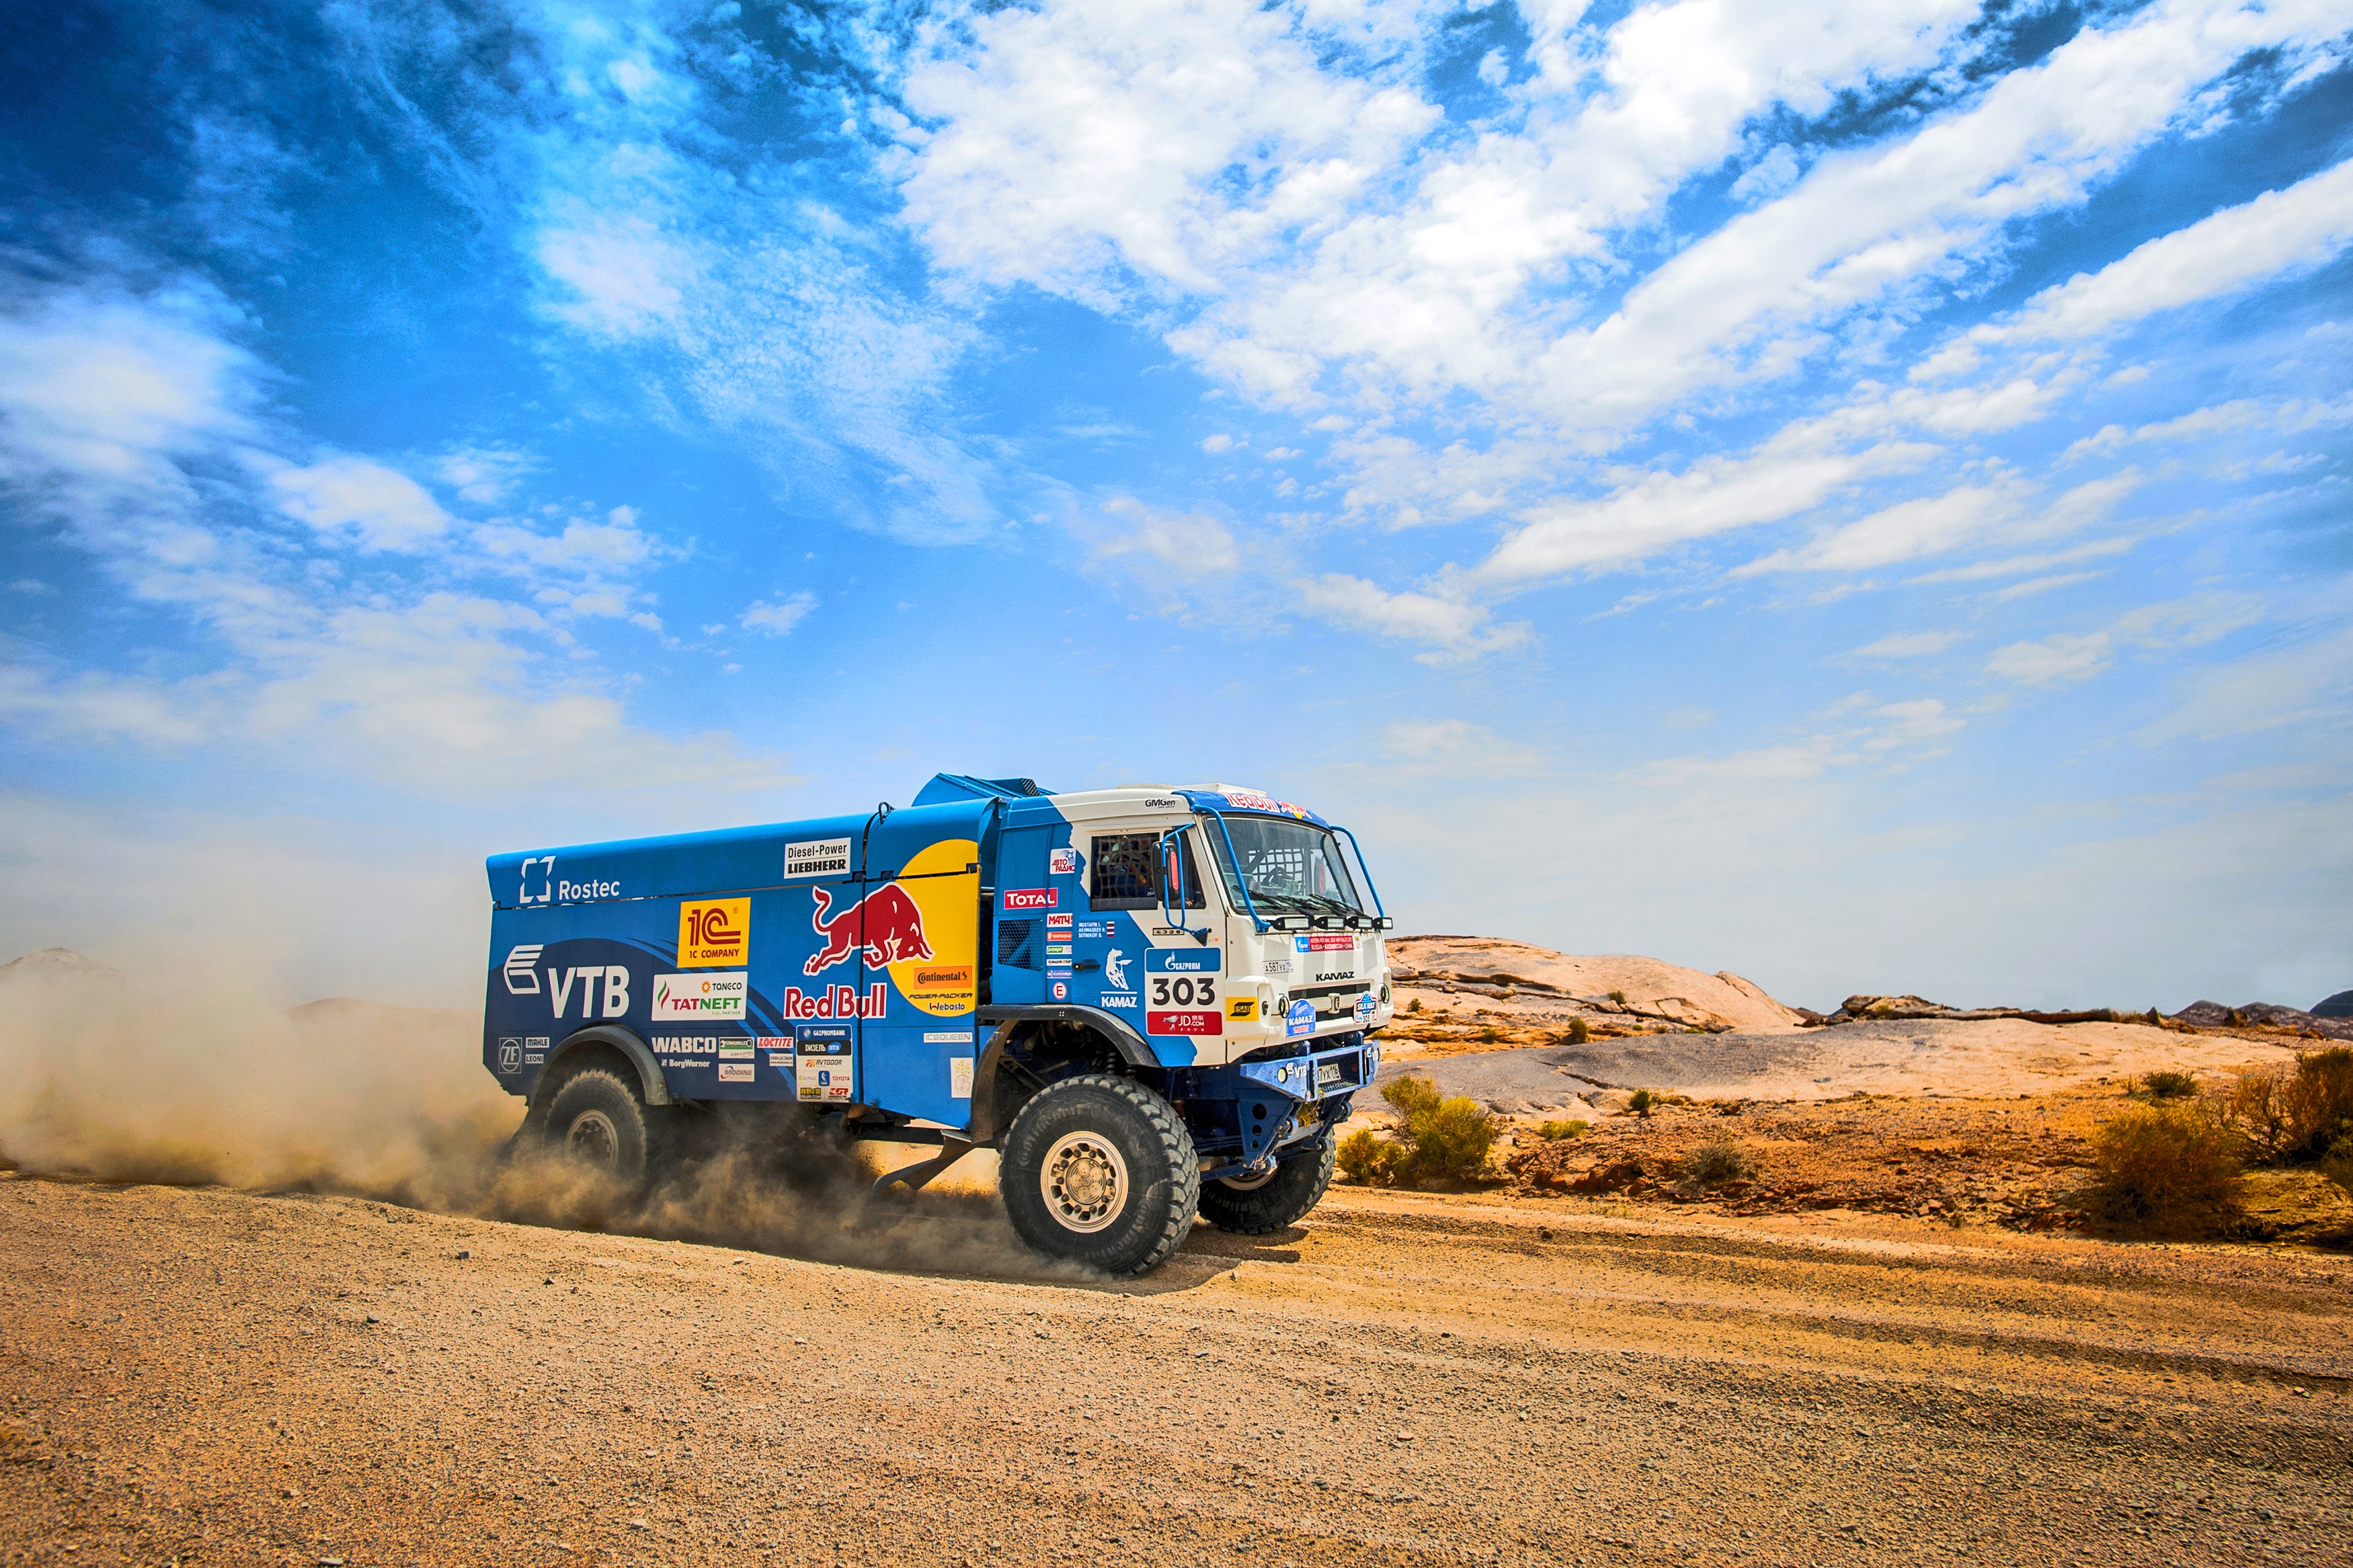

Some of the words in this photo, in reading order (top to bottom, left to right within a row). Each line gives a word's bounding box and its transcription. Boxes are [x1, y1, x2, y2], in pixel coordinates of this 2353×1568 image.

[1145, 798, 1175, 807] GMGen
[1253, 796, 1280, 813] Bull
[788, 844, 847, 858] Diesel-Power
[787, 859, 846, 874] LIEBHERR
[559, 879, 621, 900] Rostec
[1006, 893, 1055, 906] TOTAL
[689, 950, 698, 958] 1C
[701, 948, 740, 958] COMPANY
[1174, 962, 1201, 971] GAZPROM
[917, 971, 961, 984] Continental
[1316, 971, 1355, 982] KAMAZ
[547, 965, 630, 1018] VTB
[1056, 985, 1064, 996] E
[1152, 977, 1215, 1005] 303
[672, 997, 742, 1010] TATNEFT
[784, 985, 835, 1018] Red
[836, 983, 886, 1018] Bull
[929, 1001, 965, 1010] Webasto
[1101, 996, 1138, 1007] KAMAZ
[1288, 1014, 1314, 1026] KAMAZ
[527, 1038, 549, 1046] MAHLE
[651, 1036, 717, 1053] WABCO
[758, 1038, 793, 1047] LOCTITE
[501, 1046, 521, 1065] ZF
[669, 1059, 711, 1069] BorgWarner
[1293, 1065, 1308, 1078] VTB
